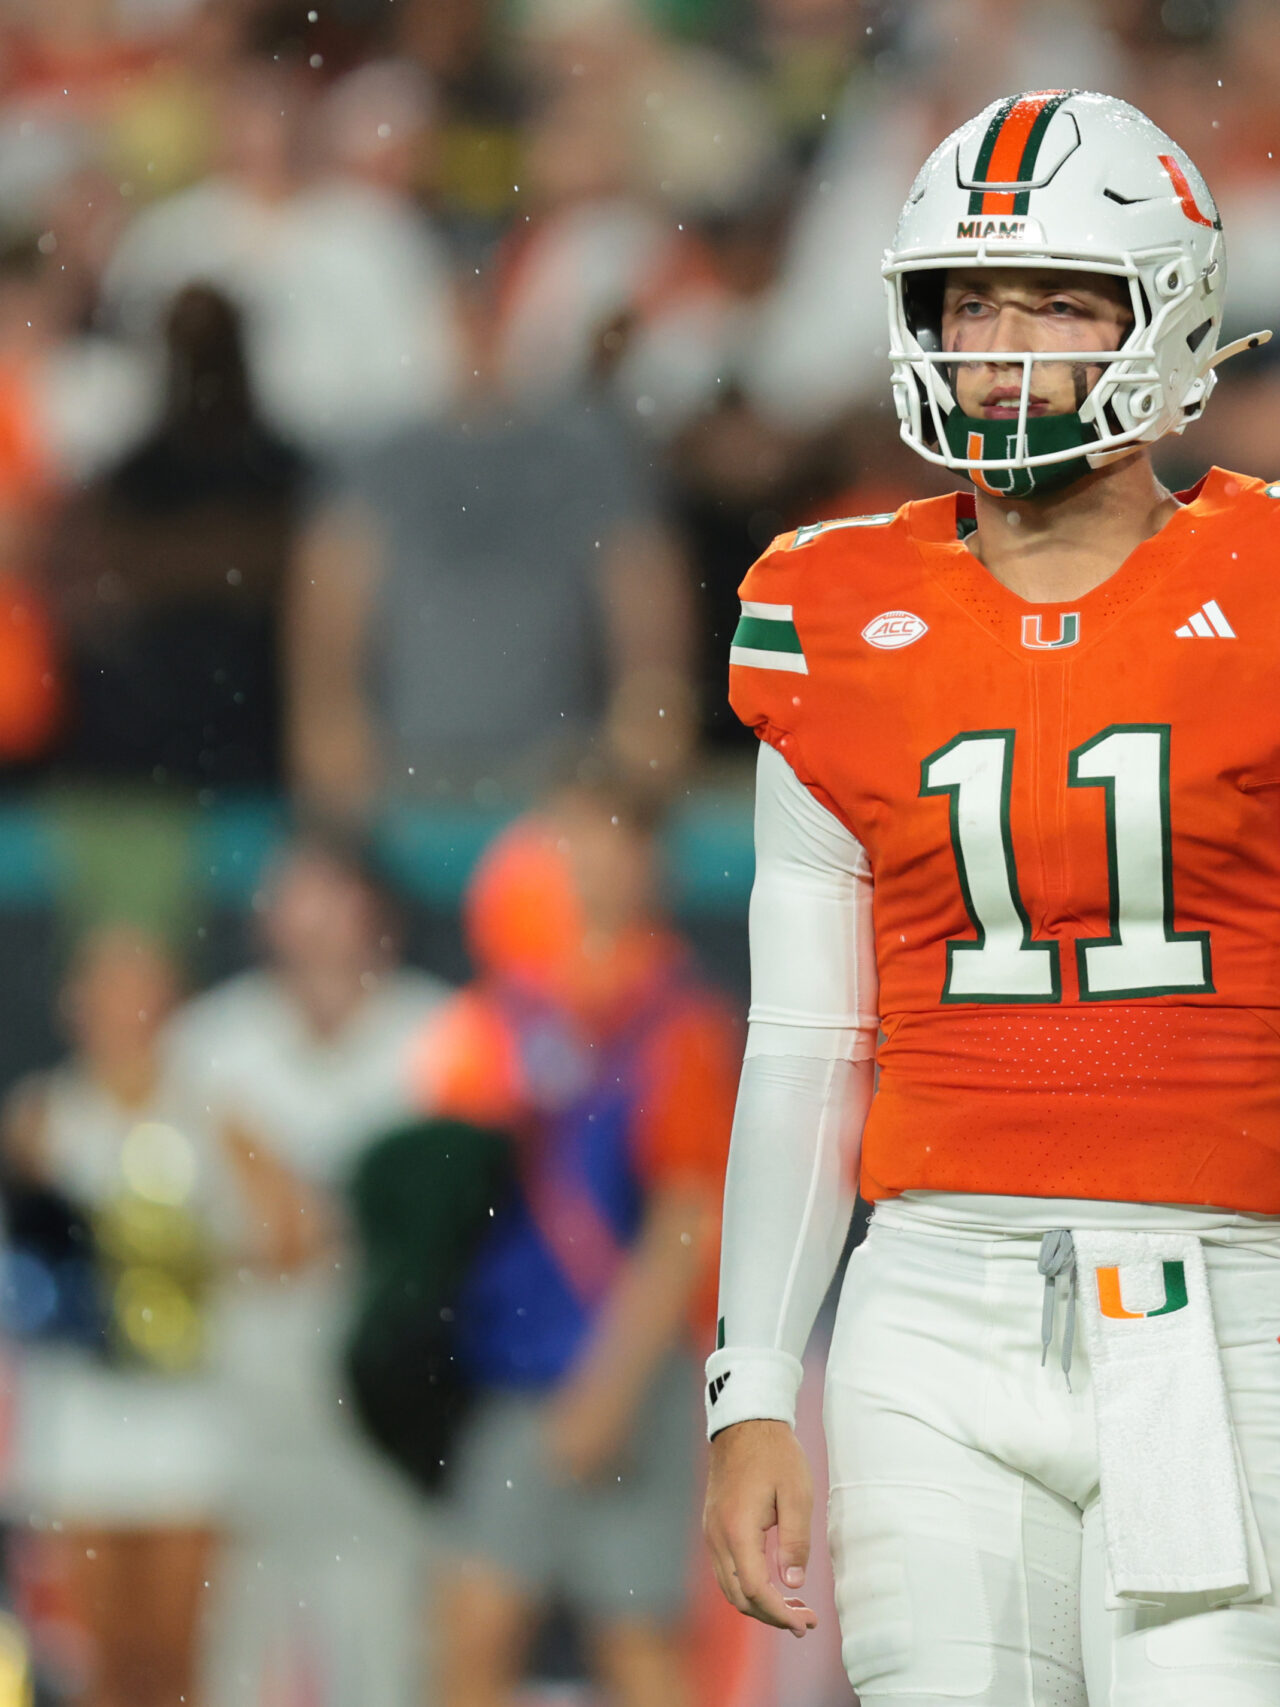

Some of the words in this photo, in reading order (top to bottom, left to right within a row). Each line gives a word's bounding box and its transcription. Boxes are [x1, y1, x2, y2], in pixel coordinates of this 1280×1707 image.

[956, 221, 1025, 239] MIAMI
[967, 431, 1035, 497] U
[872, 620, 918, 636] ACC
[1021, 612, 1081, 651] U
[918, 723, 1217, 1004] 11
[1095, 1259, 1189, 1320] U
